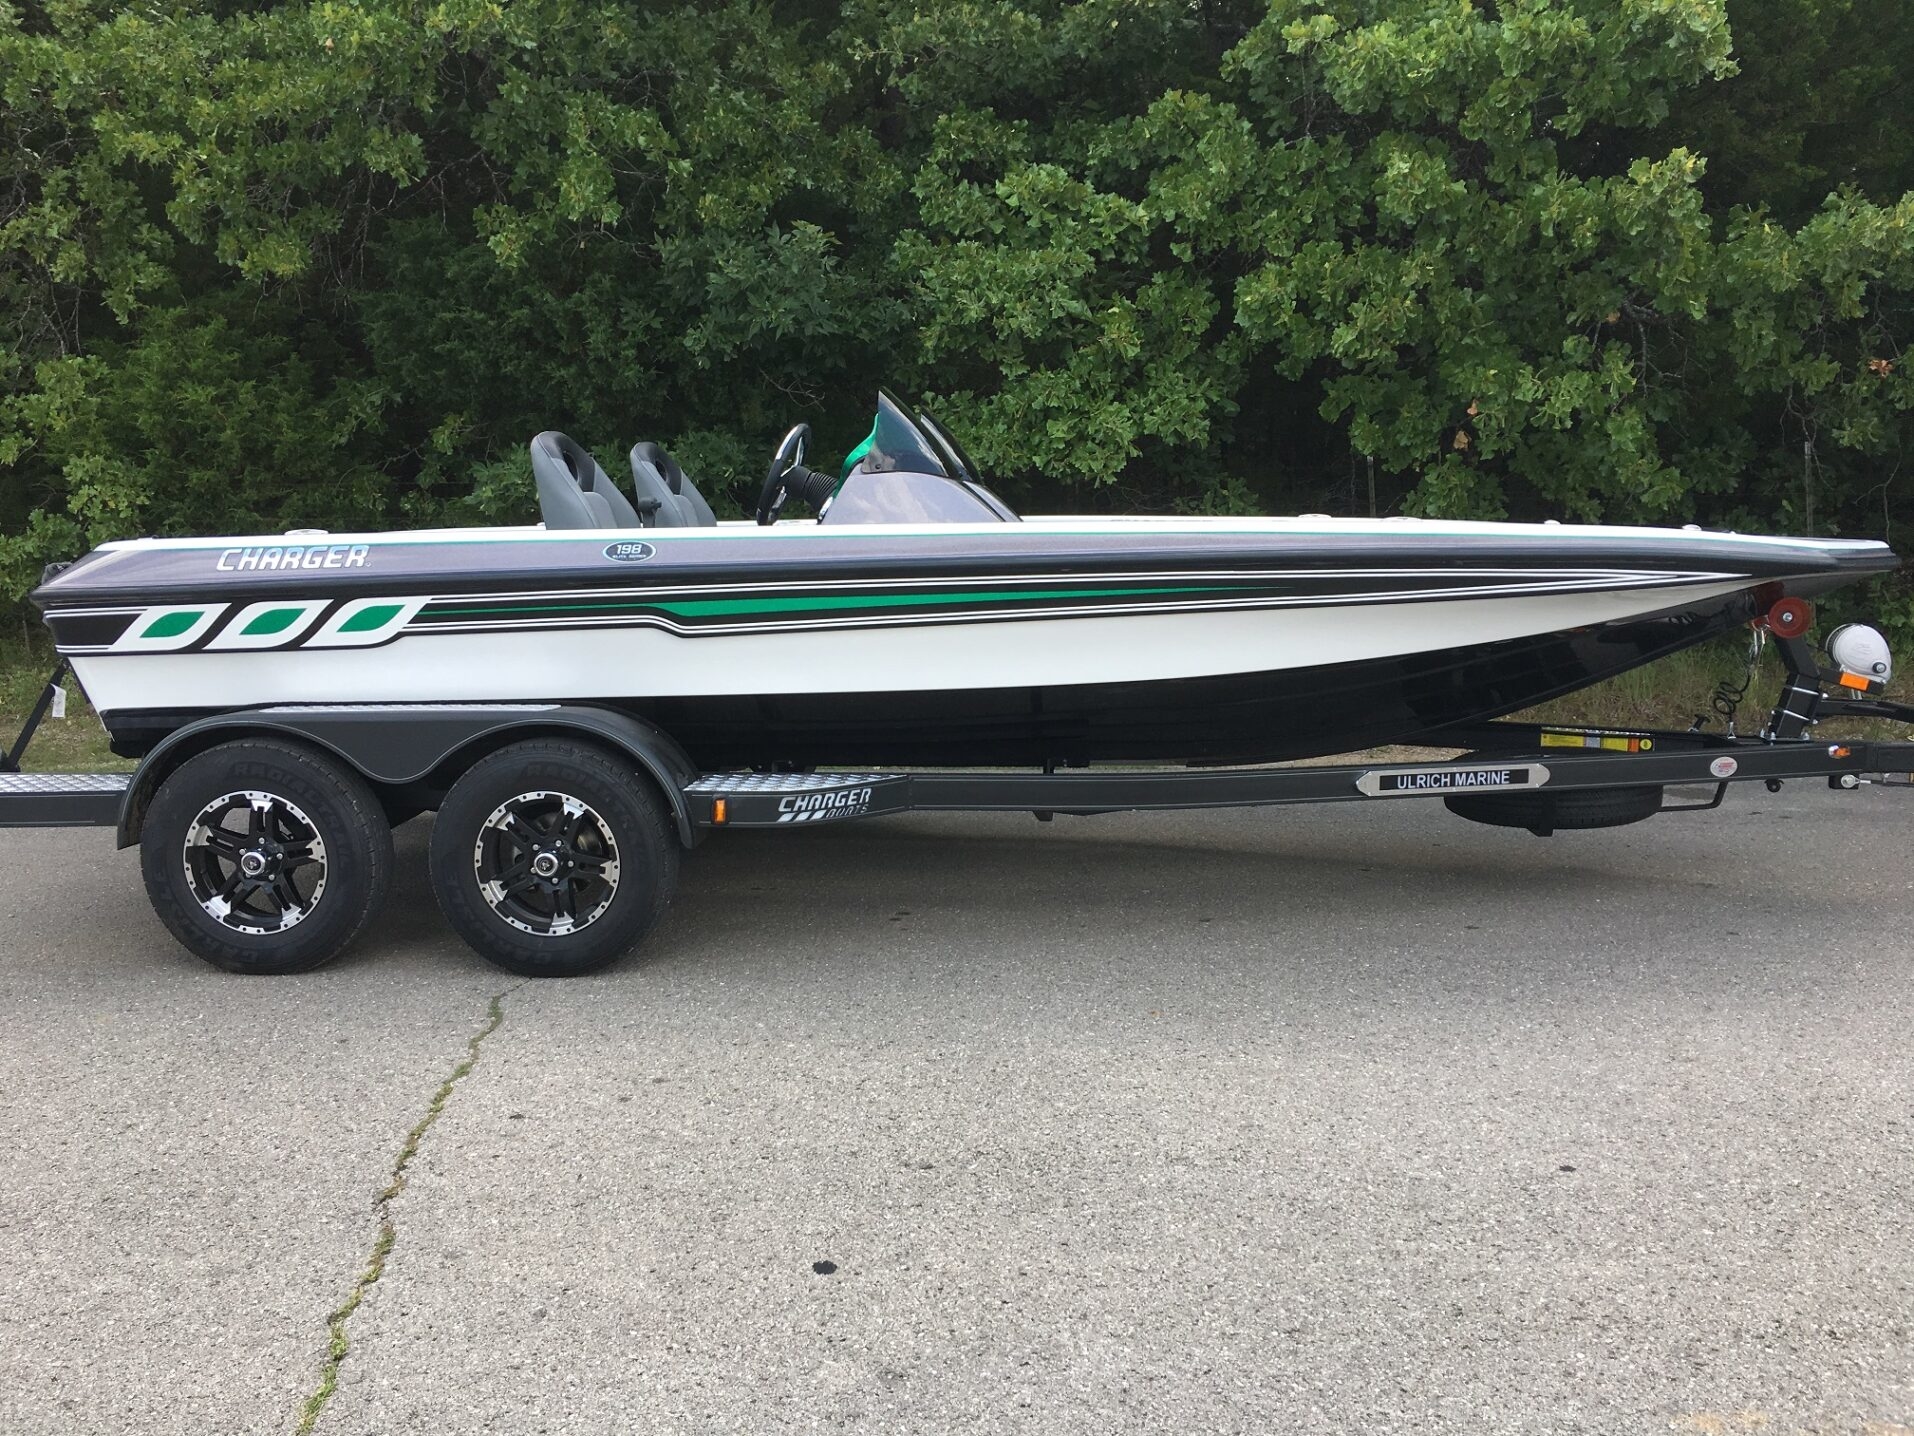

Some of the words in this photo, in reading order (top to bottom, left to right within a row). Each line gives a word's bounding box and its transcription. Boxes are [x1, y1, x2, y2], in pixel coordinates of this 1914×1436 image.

[216, 544, 370, 571] CHARGER
[616, 544, 643, 554] 198
[1398, 774, 1450, 789] ULRICH
[1455, 771, 1510, 787] MARINE
[779, 788, 871, 811] CHARGER
